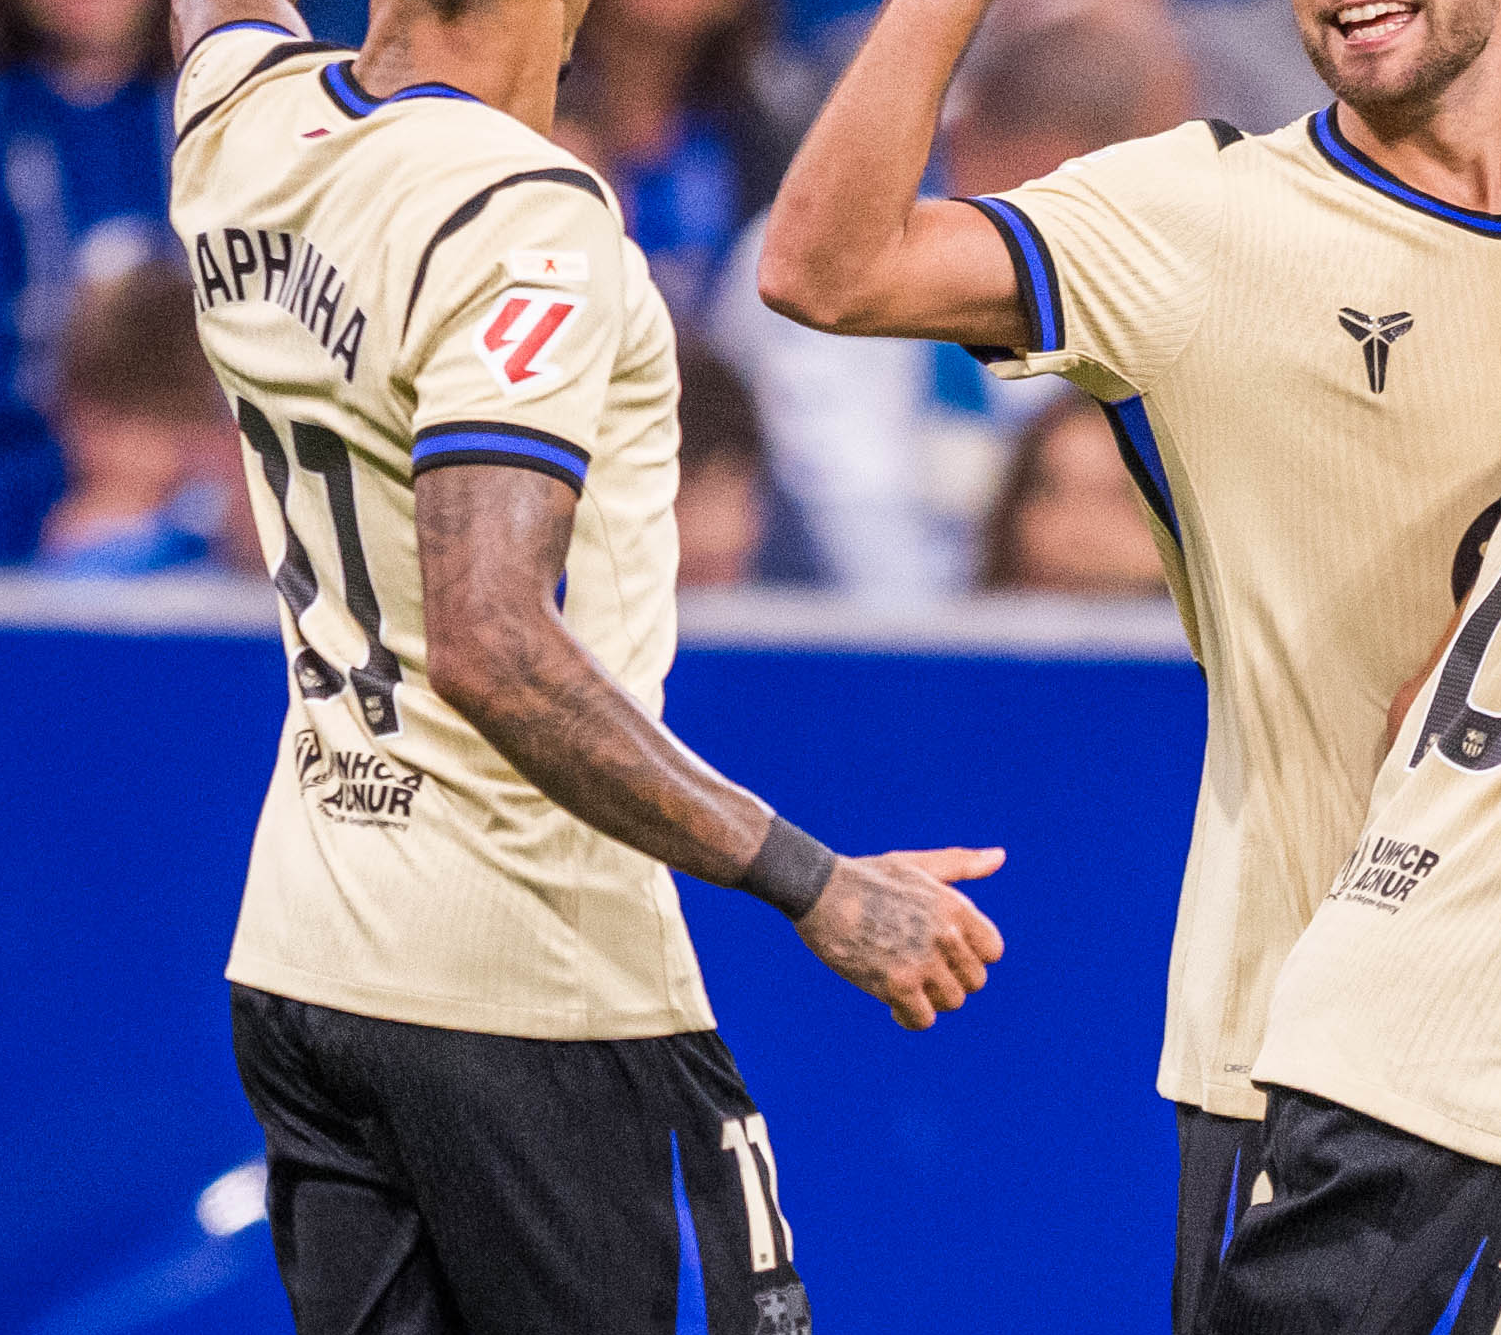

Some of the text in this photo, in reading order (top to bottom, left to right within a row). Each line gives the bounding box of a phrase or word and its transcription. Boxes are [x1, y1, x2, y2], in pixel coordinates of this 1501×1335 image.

[193, 227, 367, 383] APHNHA
[322, 783, 414, 817] ANUR
[1351, 866, 1419, 902] ACNUR
[721, 1112, 794, 1272] 11
